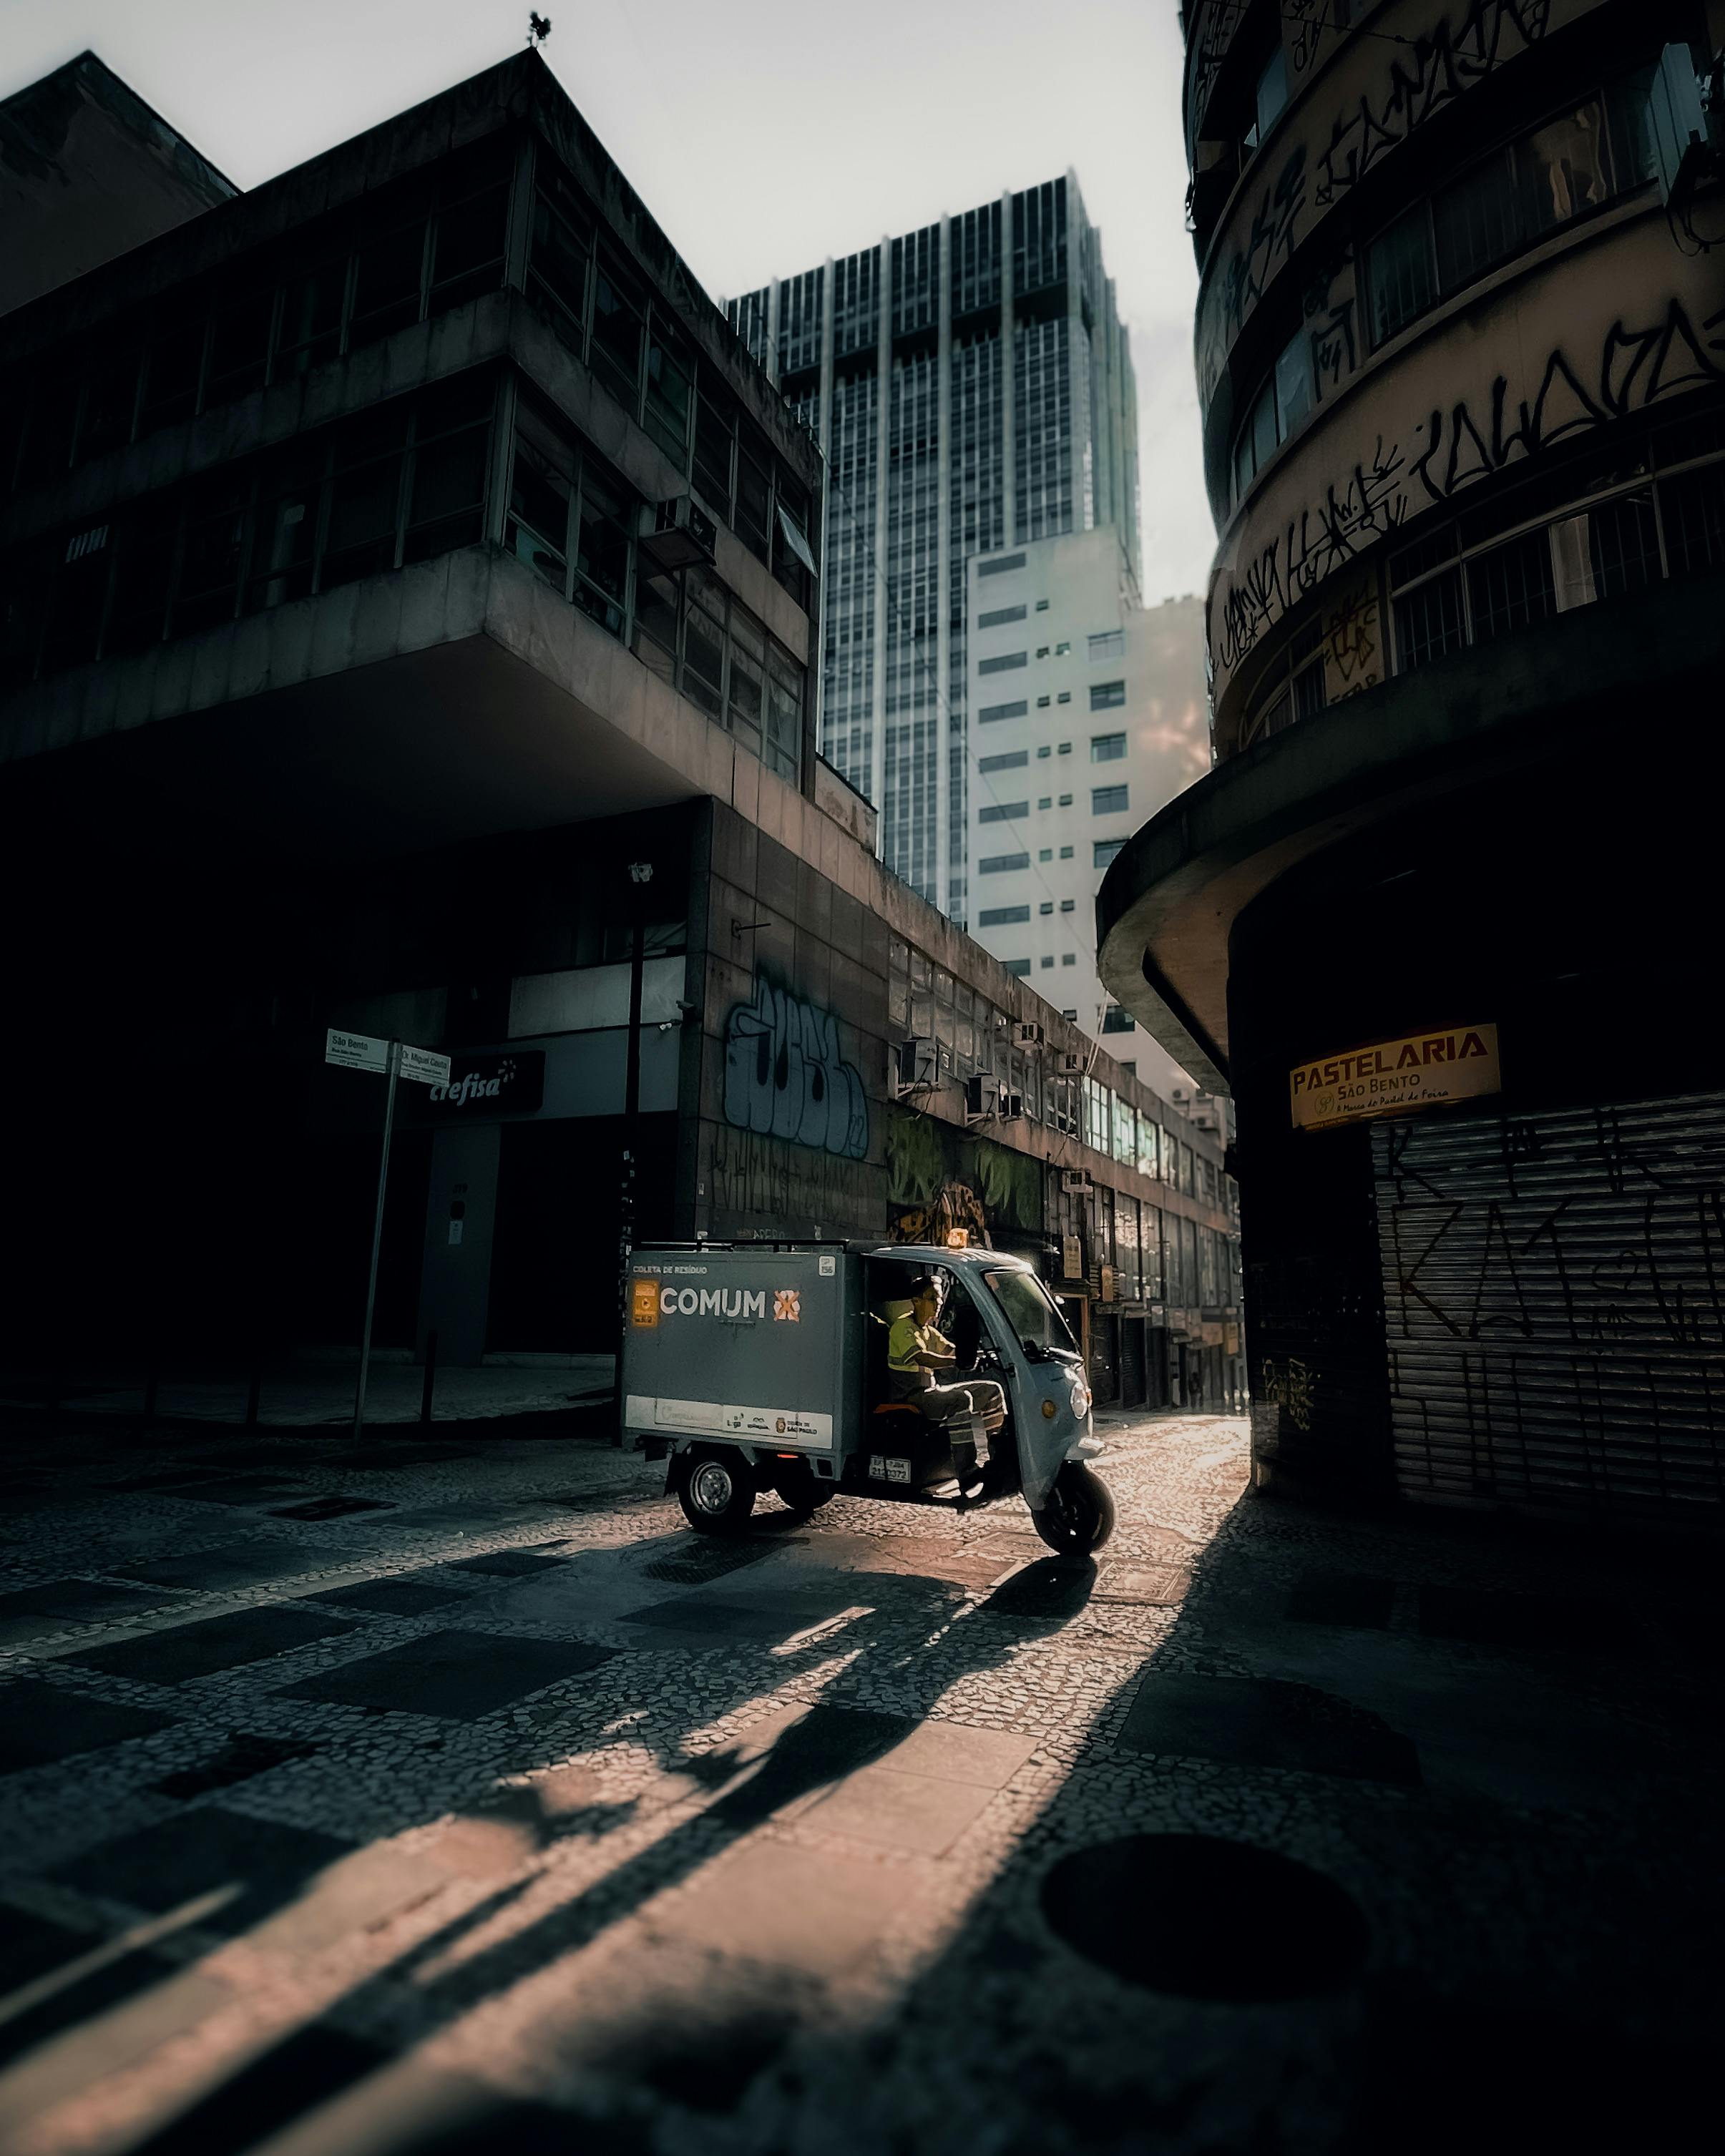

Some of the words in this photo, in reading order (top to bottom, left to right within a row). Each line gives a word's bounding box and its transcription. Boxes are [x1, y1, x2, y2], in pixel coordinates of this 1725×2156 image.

[332, 1035, 346, 1046] São
[348, 1039, 368, 1050] Bento
[1293, 1032, 1489, 1095] PASTELARIA
[429, 1072, 501, 1107] crefisa
[1337, 1082, 1366, 1100] SÃO
[1370, 1074, 1422, 1094] BENTO
[632, 1265, 662, 1274] COLETA
[675, 1265, 708, 1274] RESÍDUO
[660, 1287, 766, 1319] COMUM
